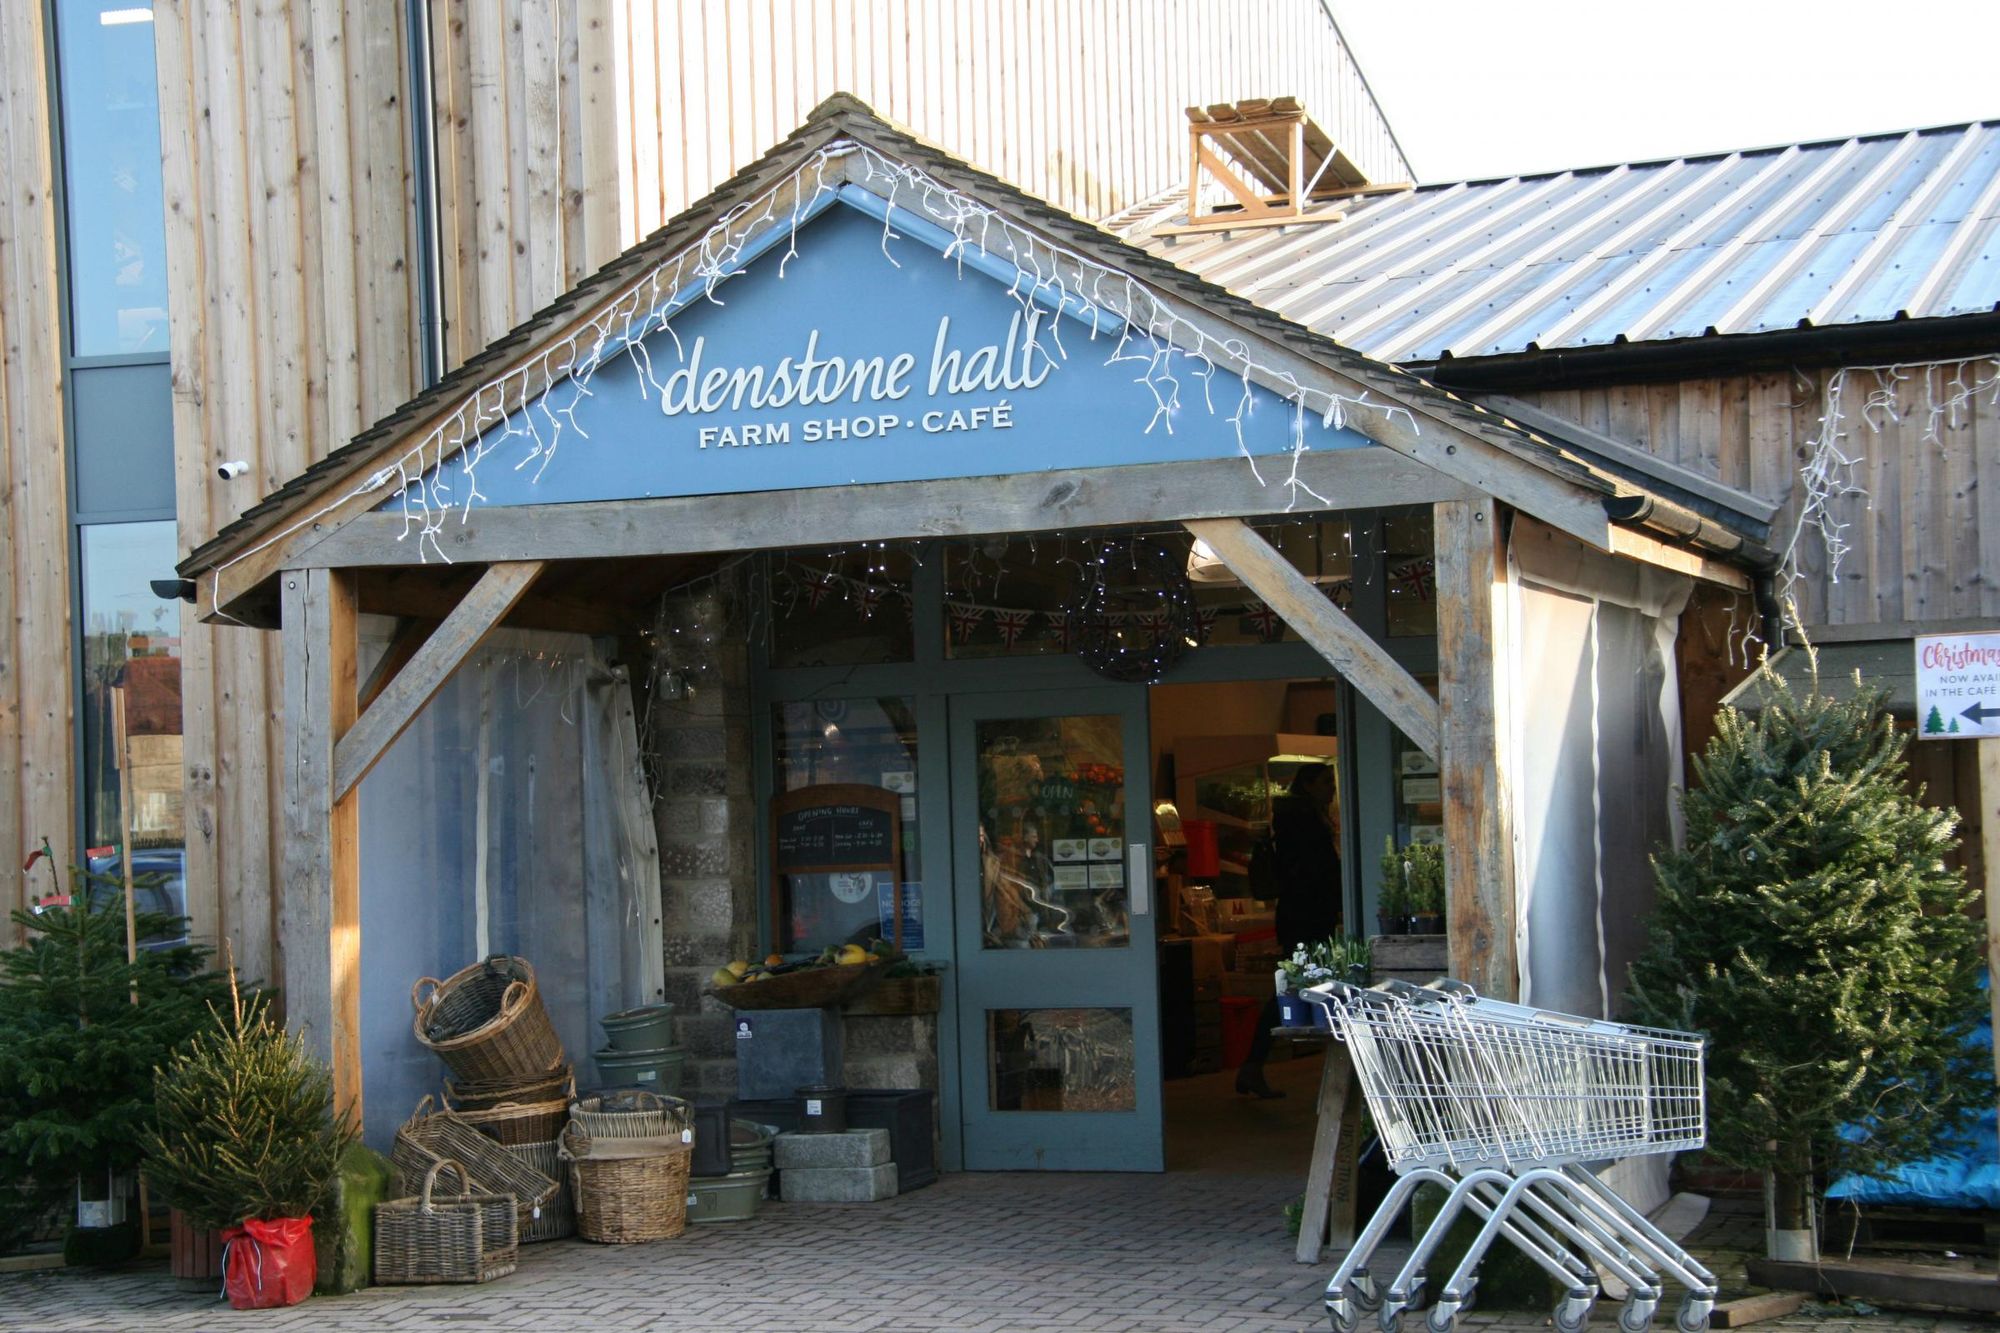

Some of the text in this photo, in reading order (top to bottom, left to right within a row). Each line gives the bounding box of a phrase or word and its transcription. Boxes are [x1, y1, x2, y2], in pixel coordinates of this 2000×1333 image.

[661, 310, 1051, 416] denstone hall
[699, 400, 1014, 449] FARM SHOP CAFÉ
[1925, 688, 1938, 697] IN
[1942, 687, 1964, 697] THE
[1940, 675, 1969, 684] NOW
